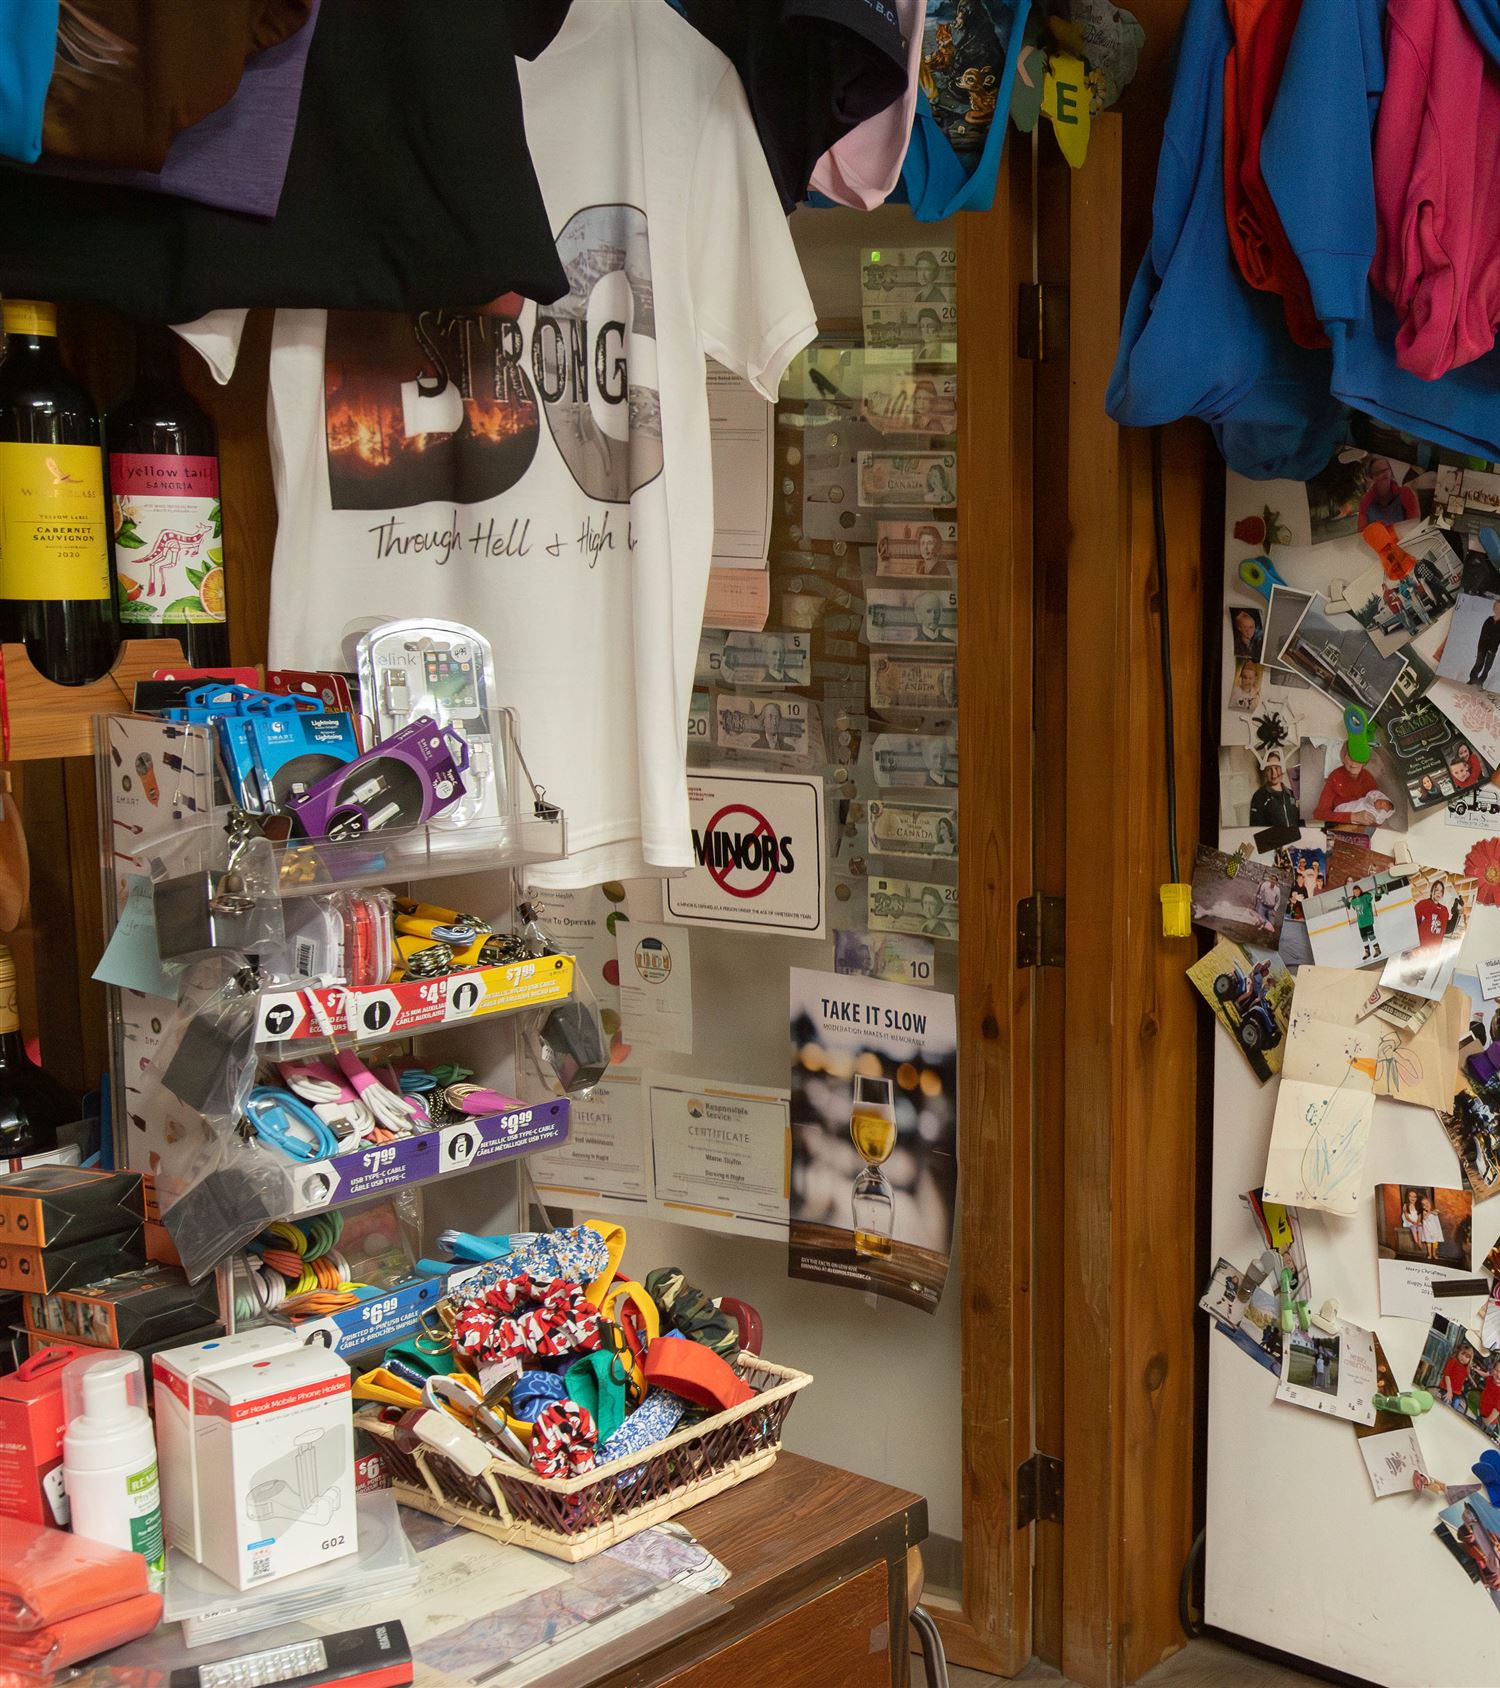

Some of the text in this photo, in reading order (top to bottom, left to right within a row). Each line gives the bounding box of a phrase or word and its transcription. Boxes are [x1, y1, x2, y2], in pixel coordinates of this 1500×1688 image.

[1056, 81, 1078, 125] E
[414, 311, 629, 405] STRONG
[146, 482, 193, 490] SANGRIA
[32, 534, 95, 542] SAUVIGNON
[368, 510, 462, 565] Through
[469, 518, 531, 558] Hell
[577, 511, 615, 568] High
[948, 526, 956, 538] 2
[793, 636, 801, 647] 5
[709, 653, 722, 670] 5
[788, 704, 800, 716] 10
[311, 719, 340, 728] Lightning
[687, 718, 707, 736] 20
[314, 733, 343, 742] Lightning
[896, 828, 934, 839] CANADA
[692, 829, 795, 874] MINORS
[553, 917, 597, 926] To Operate
[909, 961, 930, 979] 10
[821, 998, 927, 1035] TAKE IT SLOW
[823, 1023, 862, 1035] MODERATION
[705, 1102, 749, 1116] Responsible
[705, 1110, 732, 1122] Service
[481, 1123, 556, 1150] METALLIC USB TYPE-C CABLE
[687, 1125, 751, 1144] CERTIFICATE
[476, 1130, 560, 1158] CÂBLE MÉTALLIQUE USB TYPE-C
[350, 1165, 407, 1185] USB TYPE-C CABLE
[350, 1172, 407, 1194] CÂBLE USB TYPE-C
[236, 1407, 250, 1419] Car
[250, 1400, 272, 1415] Hook
[271, 1393, 298, 1410] Mobile
[297, 1388, 322, 1404] Phone
[321, 1380, 348, 1398] Holder
[321, 1534, 346, 1551] G02
